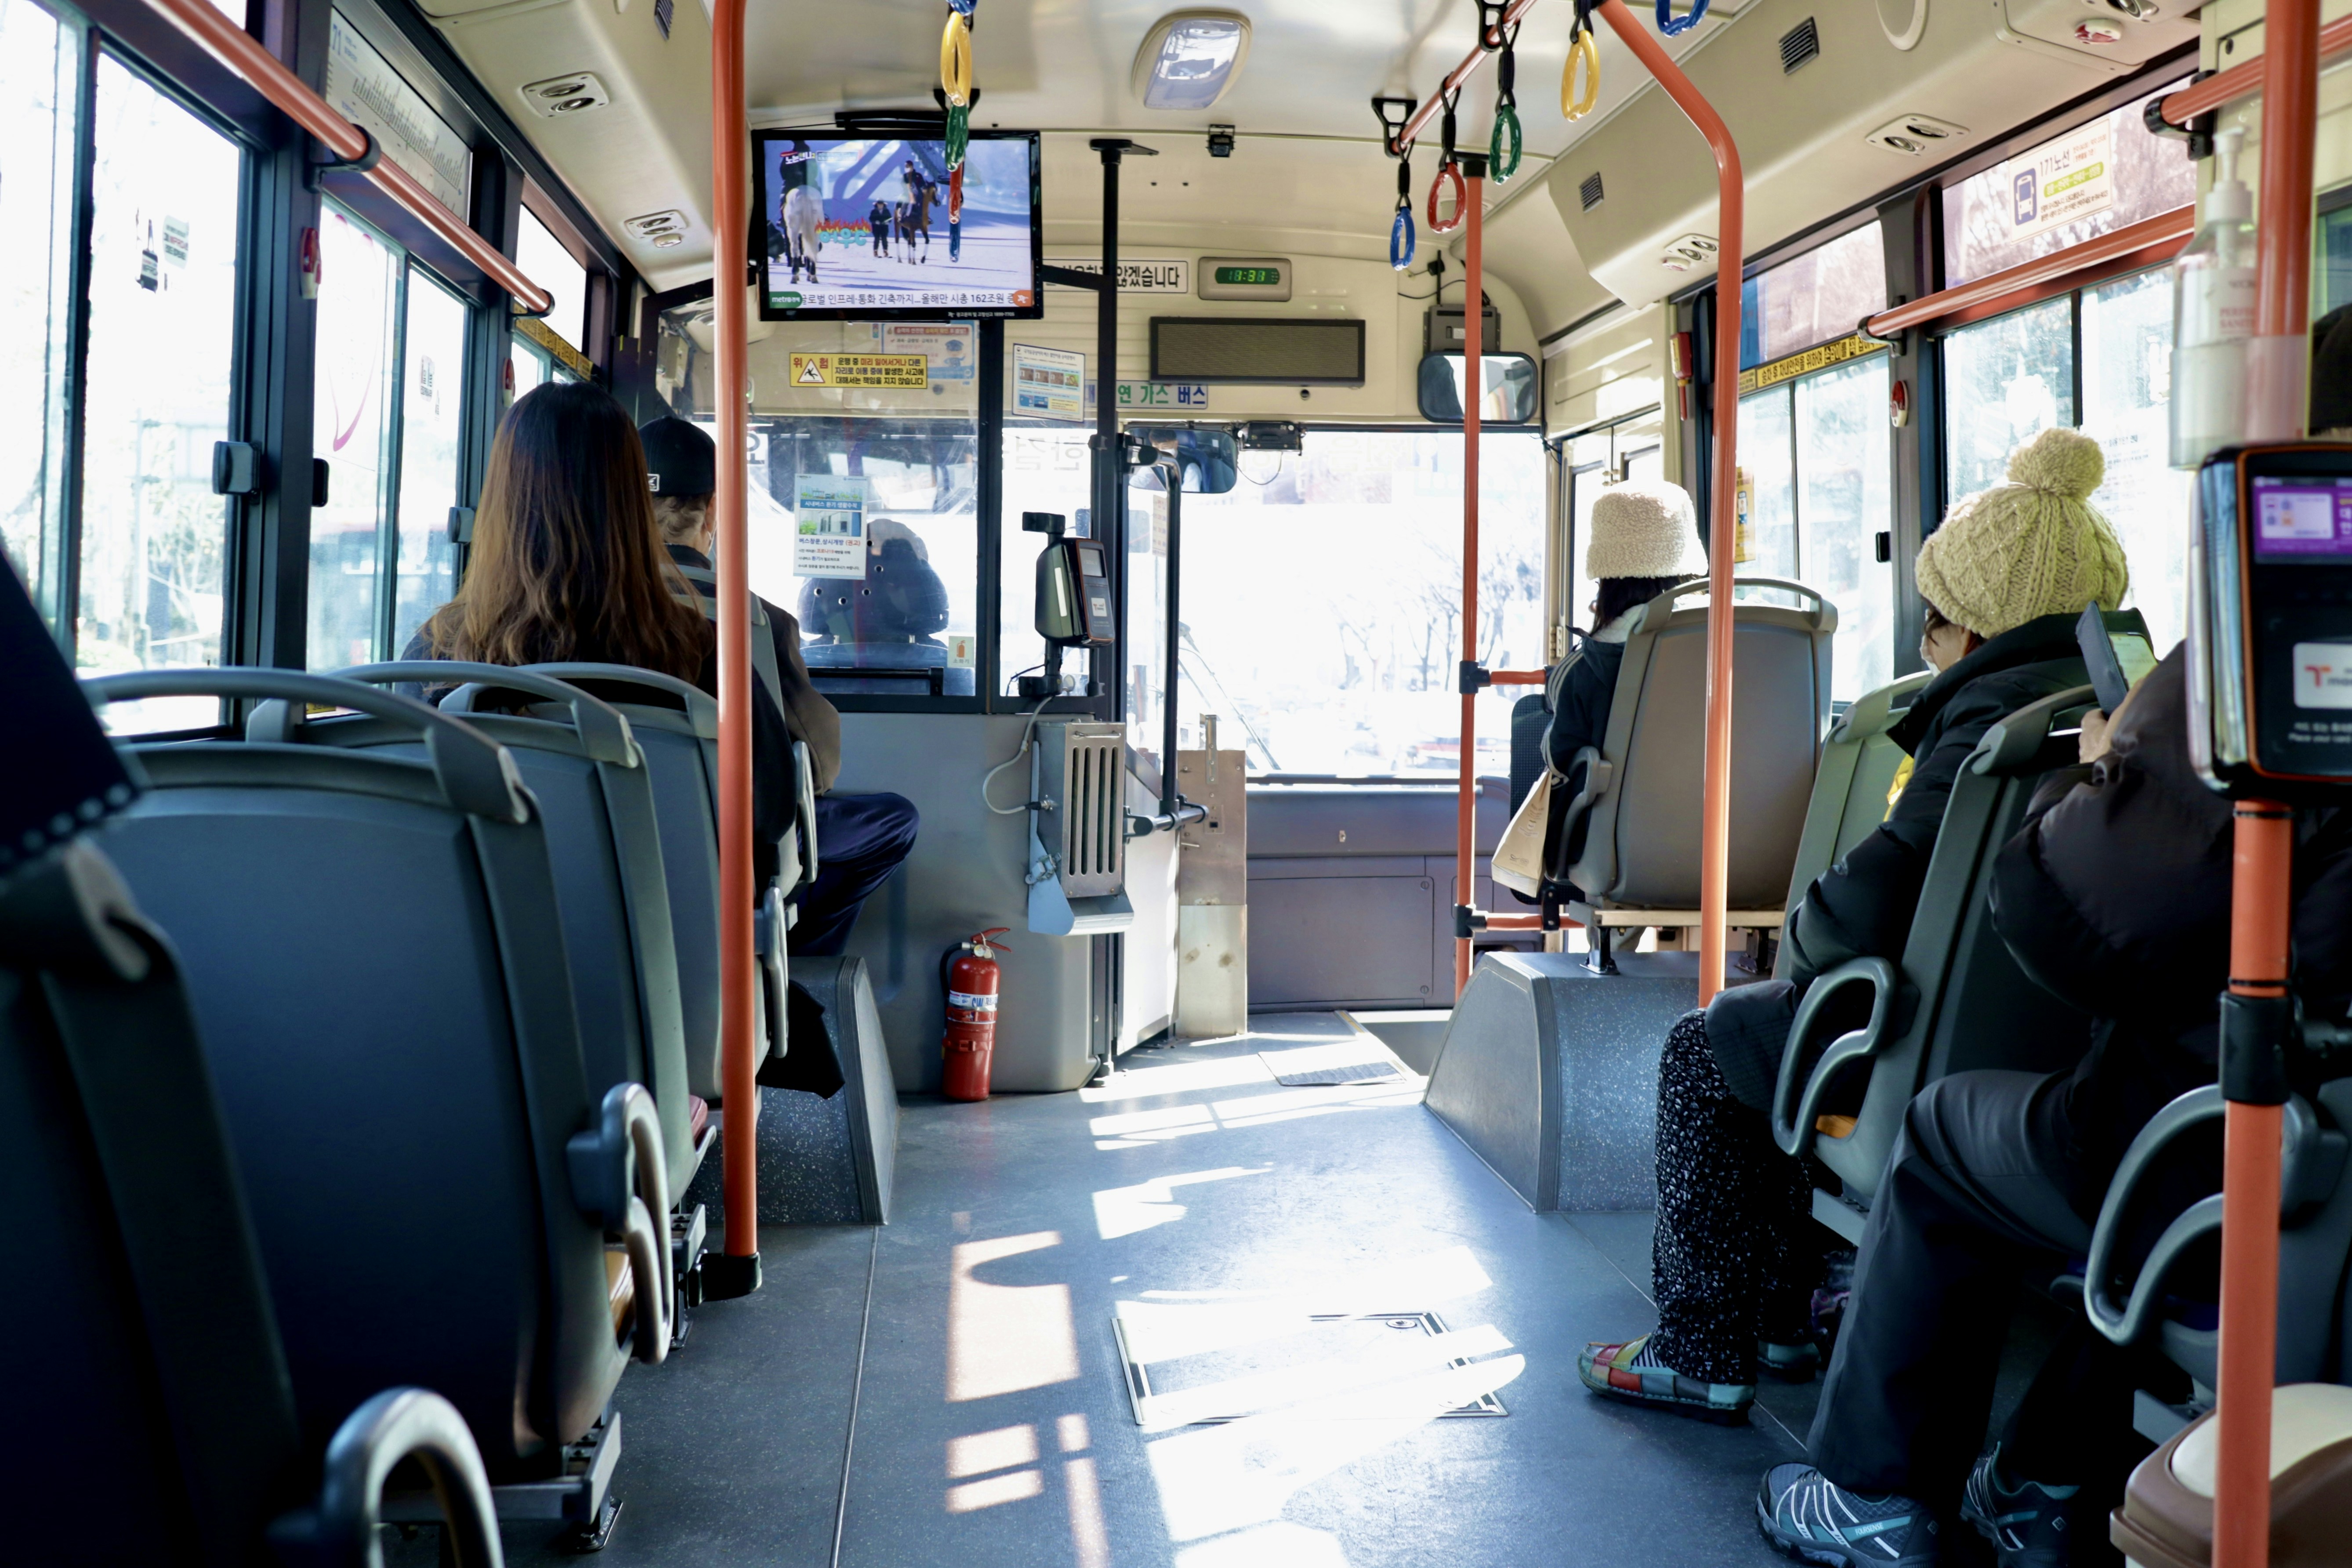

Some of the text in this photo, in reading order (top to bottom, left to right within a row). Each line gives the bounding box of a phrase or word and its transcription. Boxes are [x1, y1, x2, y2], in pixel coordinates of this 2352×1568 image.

[2040, 148, 2069, 177] 171노선
[950, 293, 968, 304] 시총
[971, 293, 1004, 304] 162조원
[793, 357, 802, 368] 위
[819, 357, 828, 369] 험
[838, 357, 850, 366] 운행
[860, 358, 873, 366] 미리
[1140, 384, 1169, 404] 가스
[1178, 384, 1206, 405] 버스
[1854, 1522, 1884, 1536] FOURSENSE
